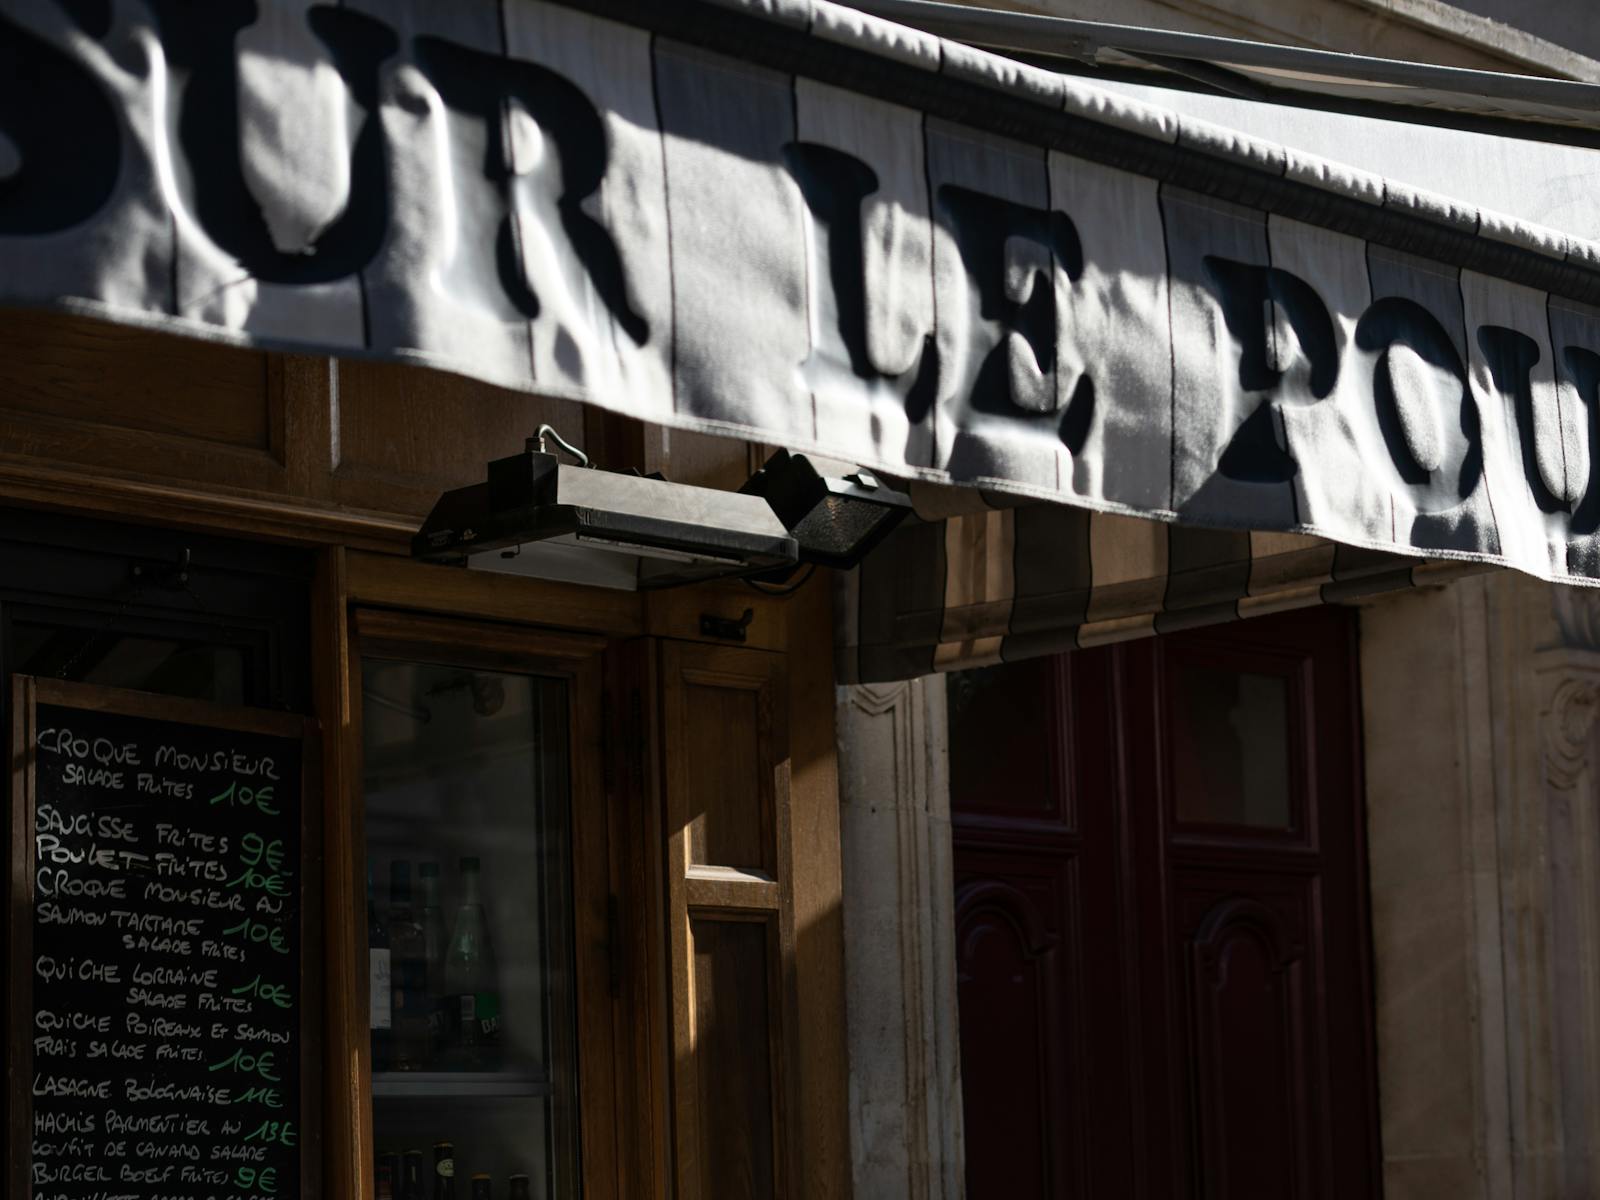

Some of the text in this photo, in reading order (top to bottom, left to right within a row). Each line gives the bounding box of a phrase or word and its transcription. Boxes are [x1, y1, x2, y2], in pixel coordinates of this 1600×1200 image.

[0, 0, 650, 348] SUR
[782, 140, 1096, 457] LE
[37, 728, 280, 780] CROQUE MONSIEUR
[62, 763, 281, 815] SALADE FRITES 10€
[36, 834, 150, 870] POULET
[155, 852, 228, 881] FRITES
[156, 824, 229, 853] FRITES
[240, 832, 286, 872] 9€
[37, 866, 283, 913] CROQUE MONSIEUR AU
[37, 903, 107, 925] SAUMON
[223, 918, 290, 953] 10€
[122, 934, 192, 955] SALADE
[36, 955, 292, 1008] QUICHE LORRAINE 10€
[126, 987, 187, 1008] SALADE
[35, 1010, 111, 1032] QUICHE
[86, 1039, 147, 1060] SALADE
[209, 1048, 281, 1081] 10€
[32, 1072, 111, 1099] LASAGNE
[34, 1109, 95, 1136] HACHIS
[104, 1140, 126, 1156] DE
[234, 1166, 277, 1192] 9€
